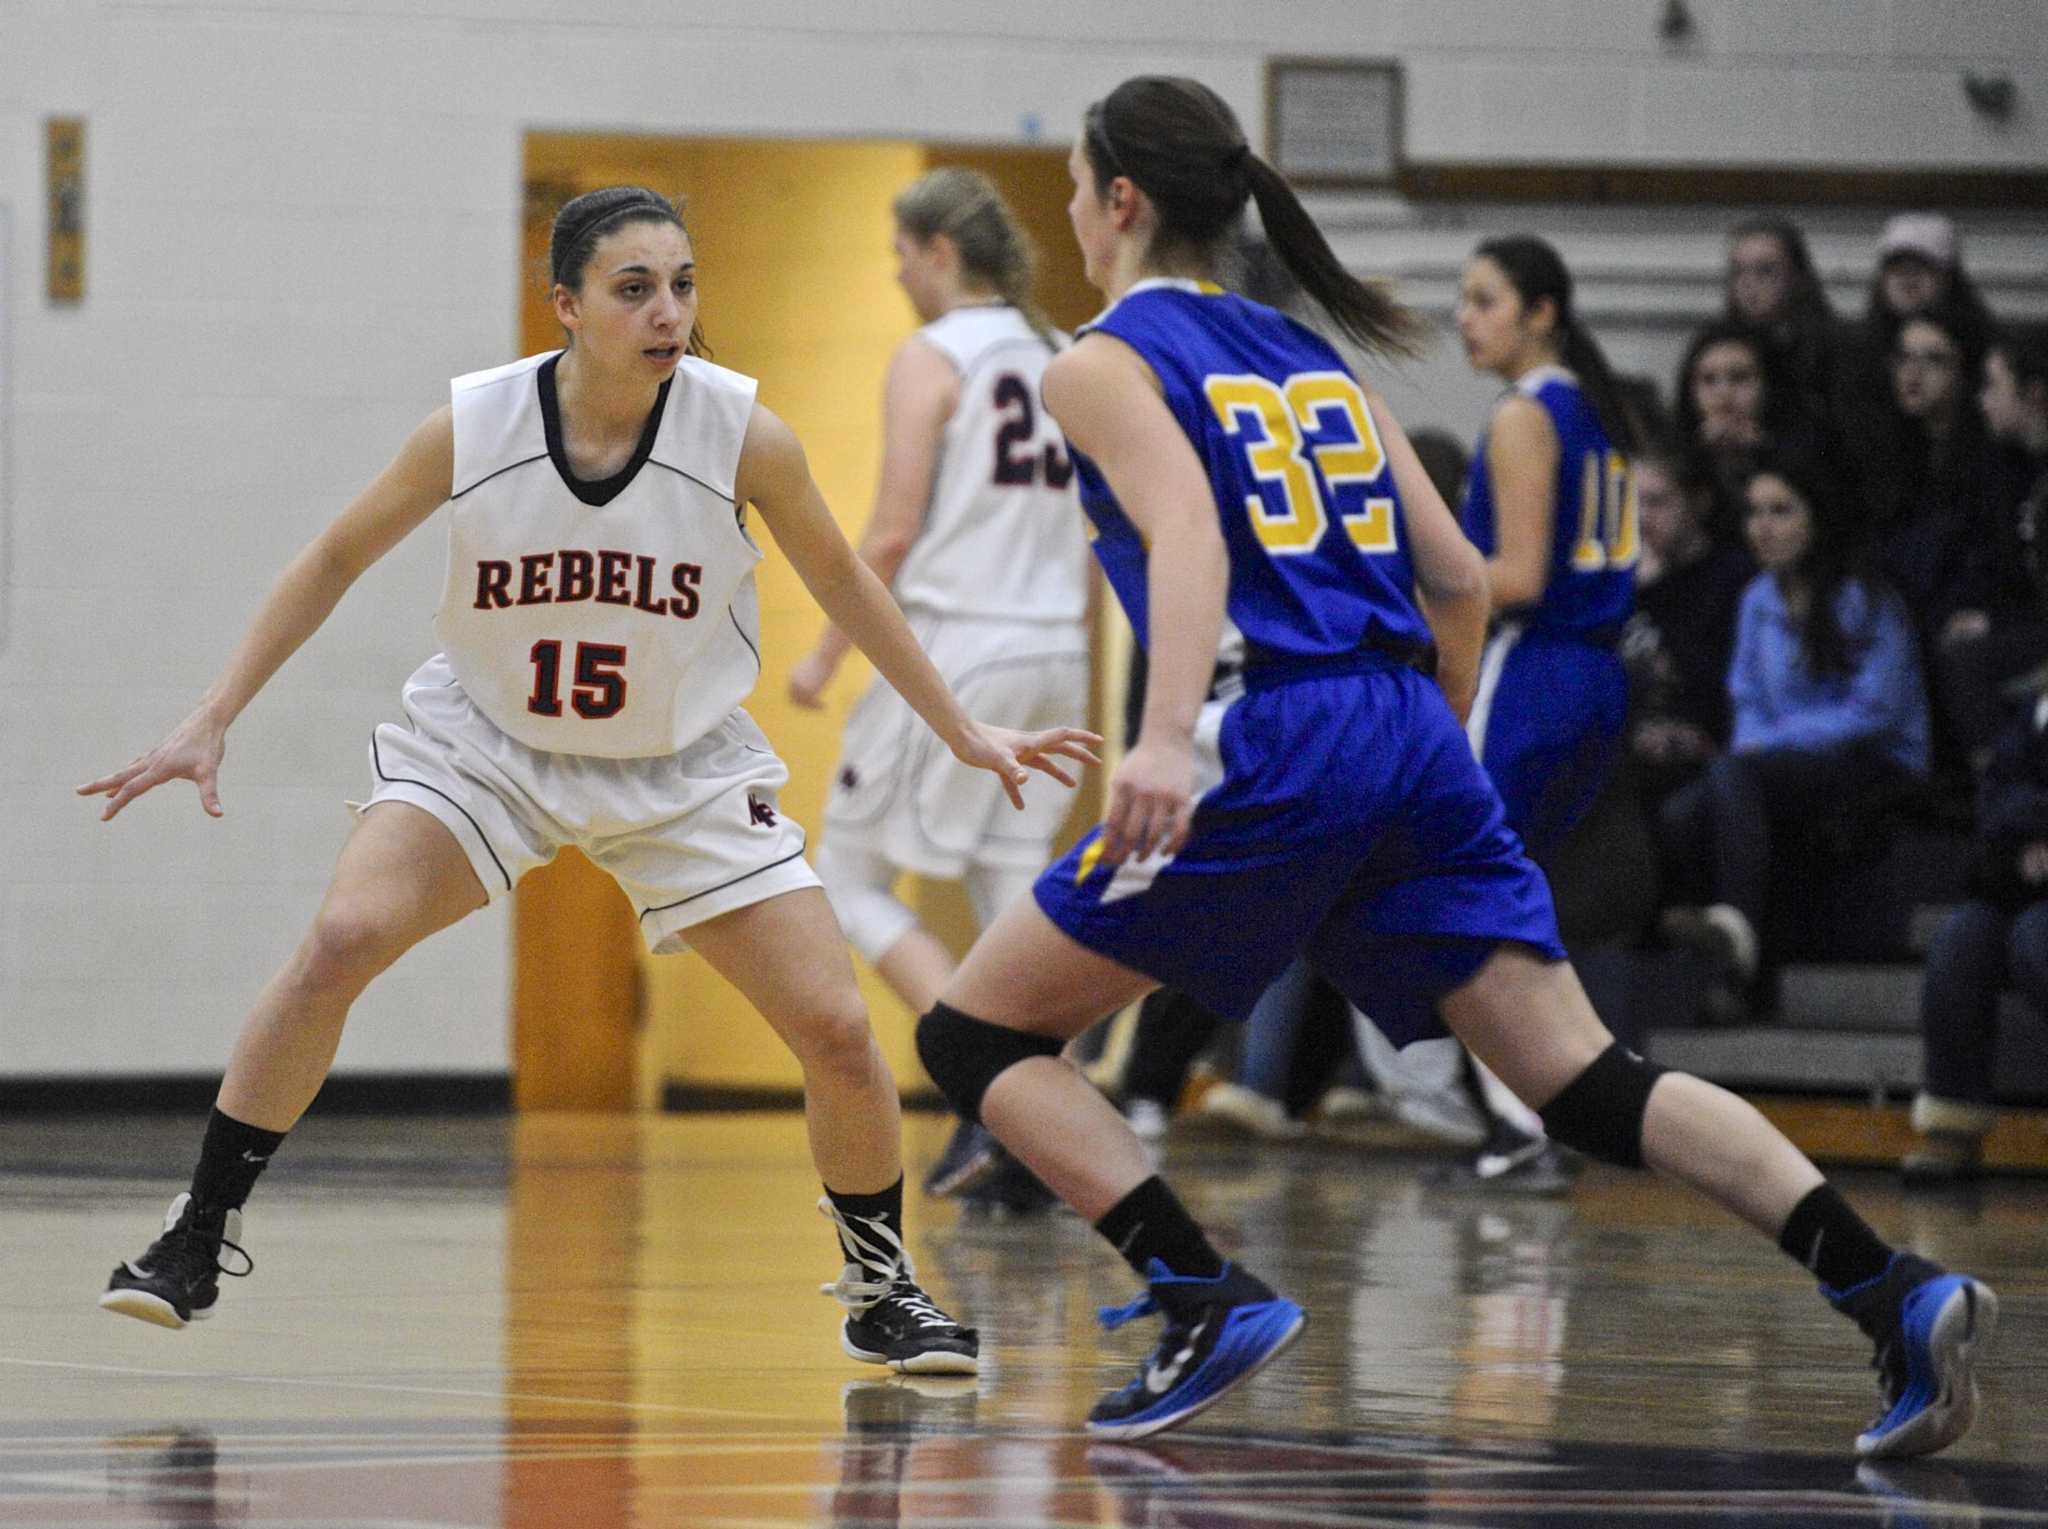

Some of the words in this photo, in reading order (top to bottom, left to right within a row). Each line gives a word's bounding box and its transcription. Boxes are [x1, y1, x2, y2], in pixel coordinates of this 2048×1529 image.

[1203, 370, 1398, 556] 32
[1570, 452, 1641, 572] 10
[473, 550, 703, 619] REBELS
[528, 639, 627, 720] 15
